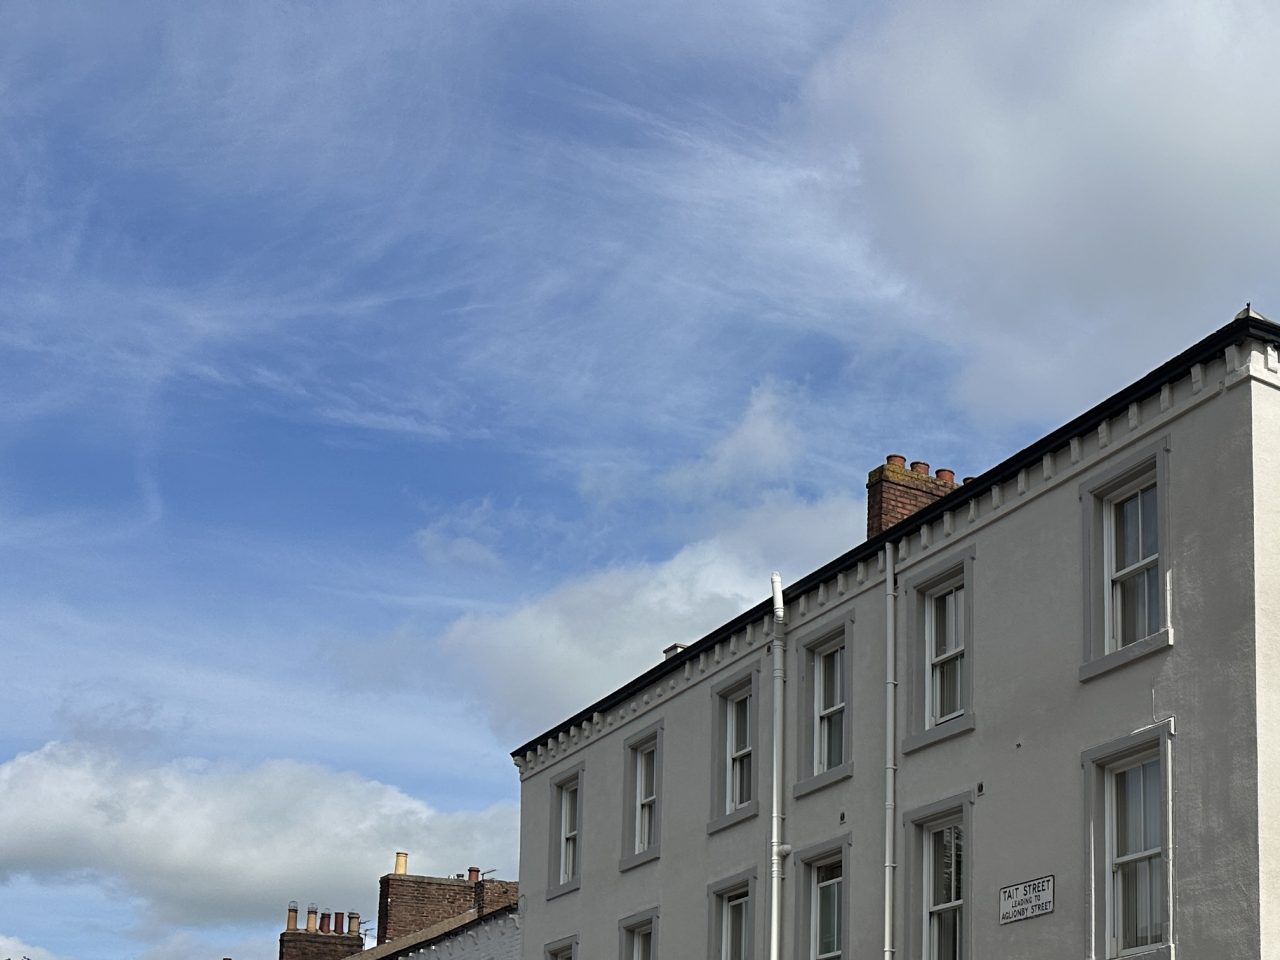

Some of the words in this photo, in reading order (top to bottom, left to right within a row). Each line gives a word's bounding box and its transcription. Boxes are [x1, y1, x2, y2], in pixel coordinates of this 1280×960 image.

[1003, 887, 1019, 901] TAIT
[1023, 879, 1051, 896] STREET
[1002, 907, 1028, 920] AGLIONBY
[1031, 901, 1052, 914] STREET
[1012, 896, 1032, 908] LEADING
